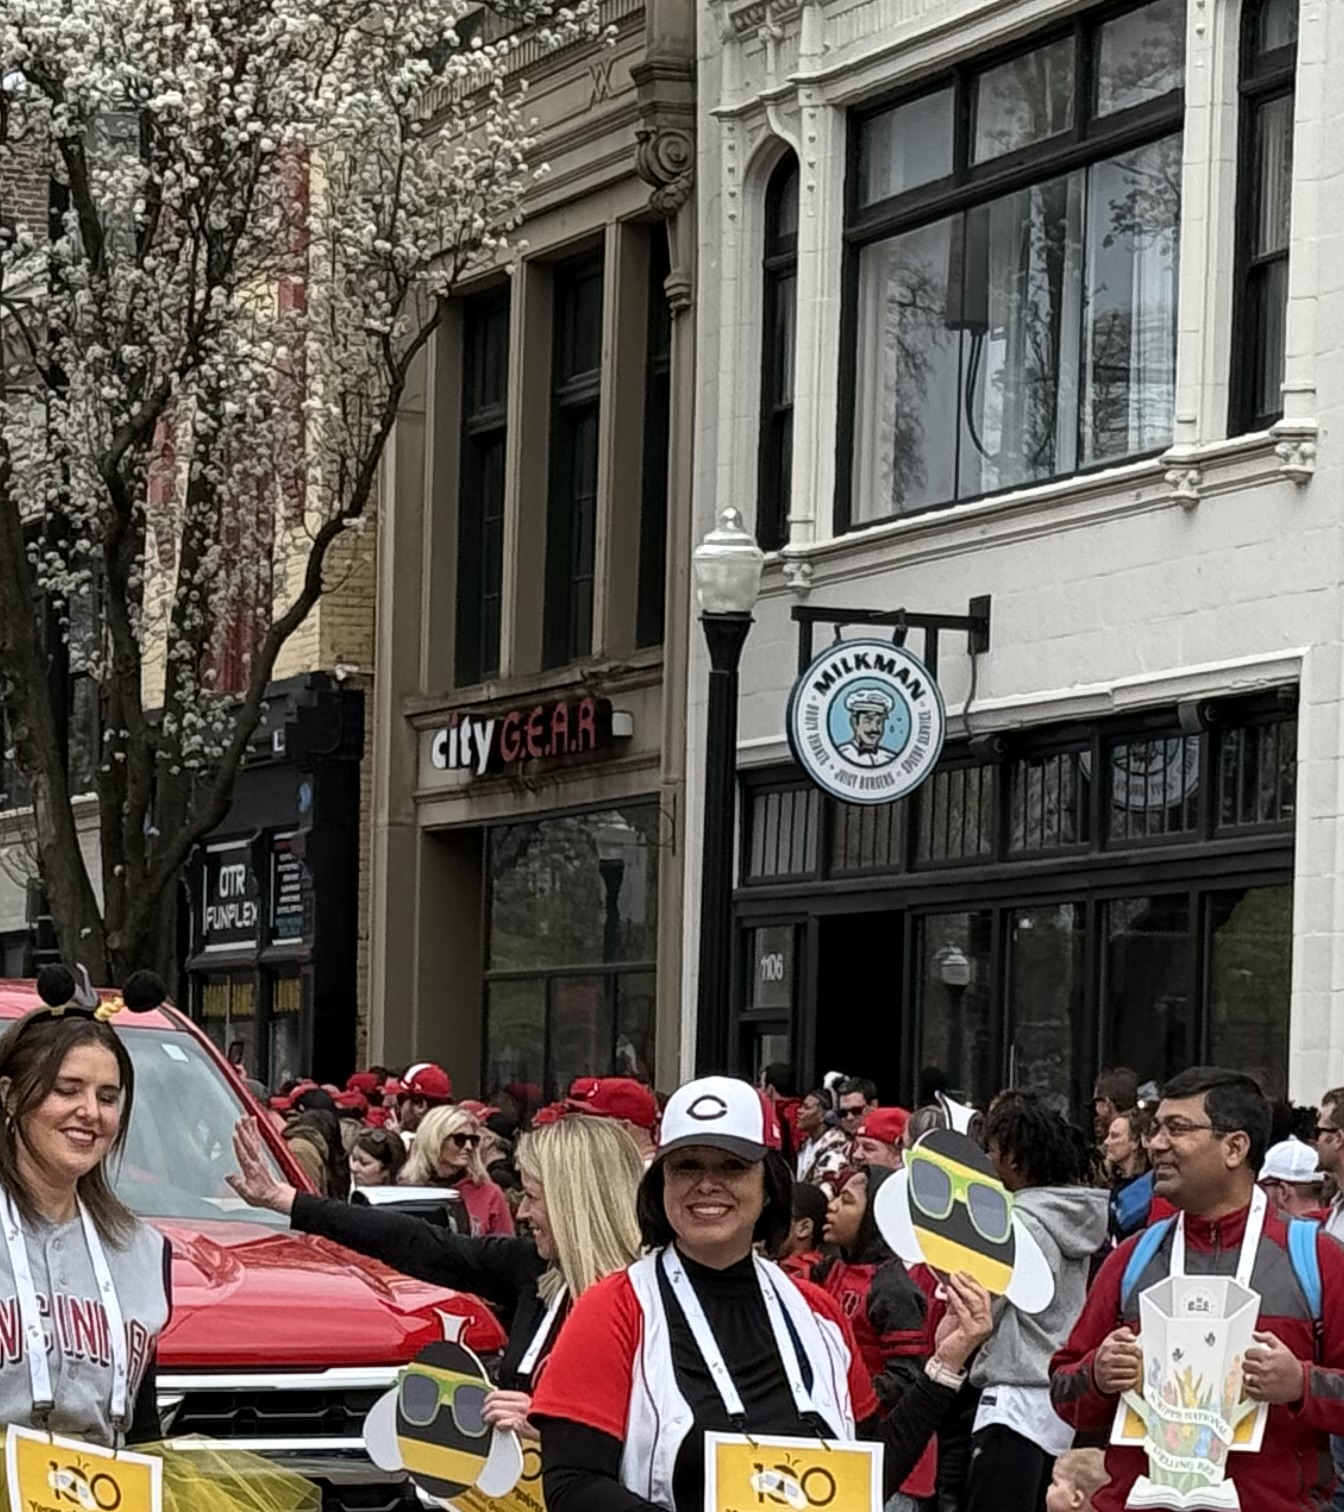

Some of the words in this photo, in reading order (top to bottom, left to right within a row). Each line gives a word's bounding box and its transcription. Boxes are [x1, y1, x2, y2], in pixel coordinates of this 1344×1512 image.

[812, 652, 927, 702] MILKMAN
[432, 710, 495, 776] city
[219, 864, 245, 897] OTR
[207, 902, 257, 930] FUNPLEX
[686, 1094, 728, 1121] C
